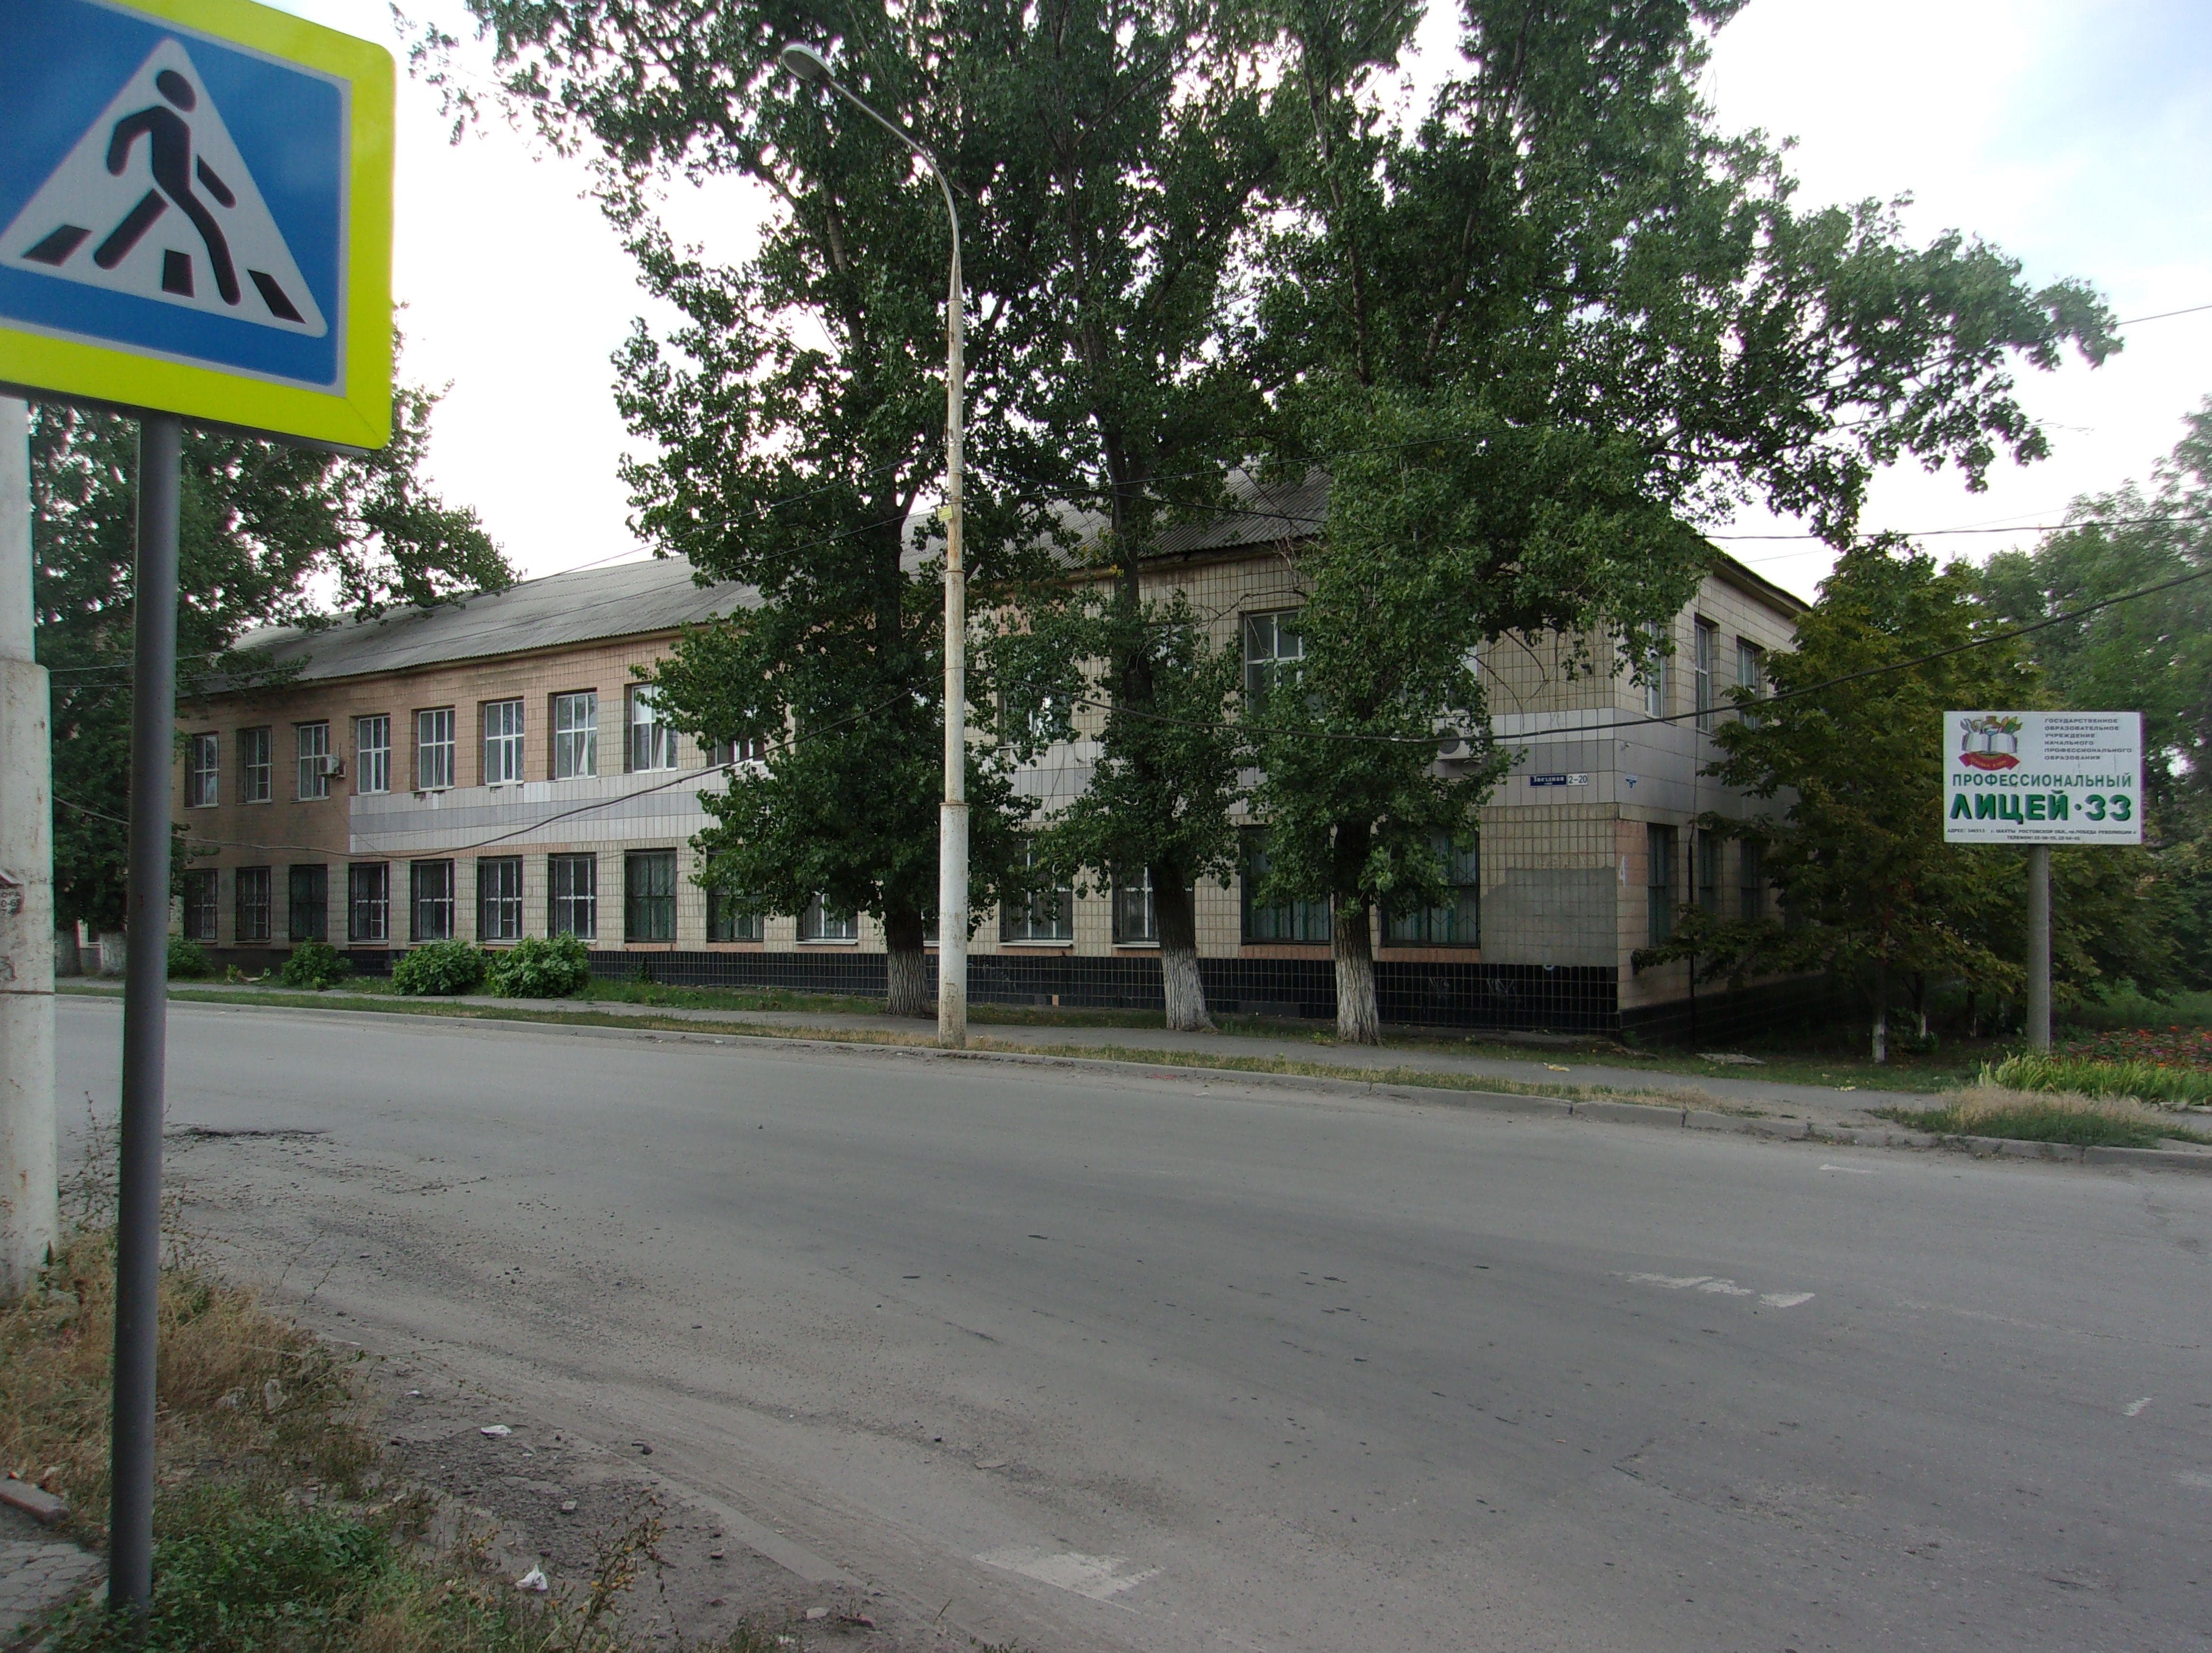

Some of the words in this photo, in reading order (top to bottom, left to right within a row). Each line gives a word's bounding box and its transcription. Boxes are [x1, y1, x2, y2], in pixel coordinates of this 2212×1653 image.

[1569, 775, 1587, 784] 2-20
[1953, 772, 2131, 787] ПРОФЕССИОНАЛЬНЫЙ
[1949, 789, 2068, 825] ЛИЦЕЙ
